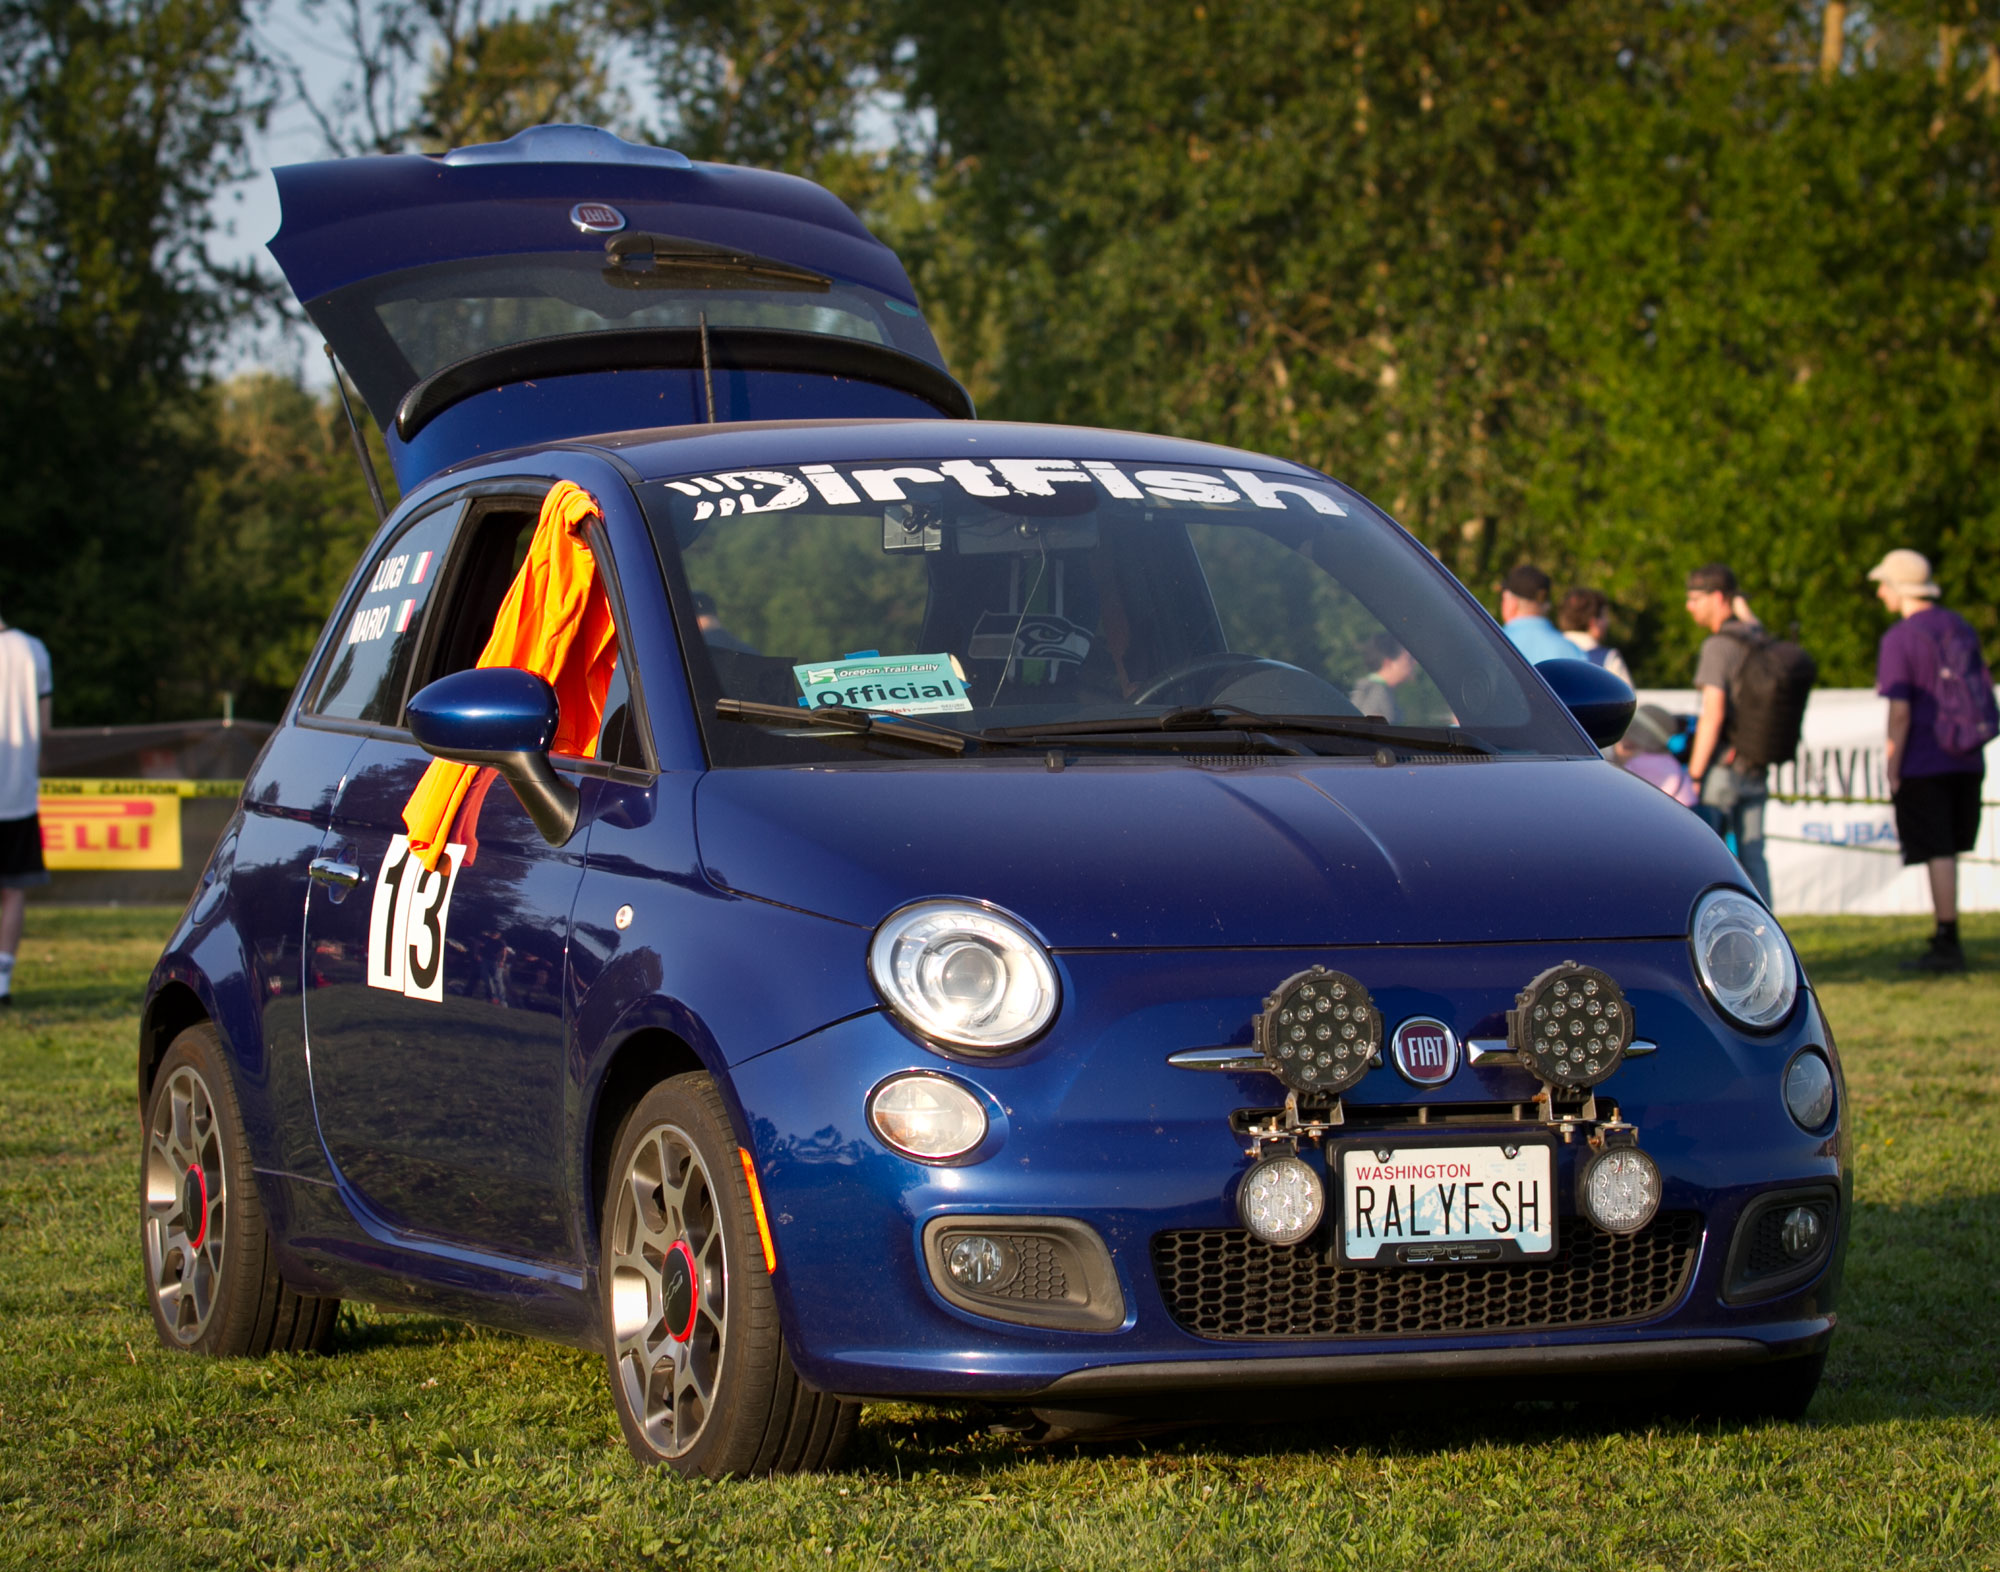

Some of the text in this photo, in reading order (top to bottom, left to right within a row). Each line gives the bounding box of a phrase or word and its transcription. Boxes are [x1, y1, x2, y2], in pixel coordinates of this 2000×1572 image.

[664, 459, 1347, 520] DirtFish
[370, 554, 410, 593] LUIGI
[347, 604, 391, 645] MARIO
[839, 664, 940, 678] Oregon Trail Rally
[816, 680, 955, 706] Official
[384, 846, 452, 990] 13
[1407, 1036, 1444, 1067] FIAT
[1356, 1163, 1471, 1180] WASHINGTON
[1355, 1180, 1539, 1239] RALYFSH
